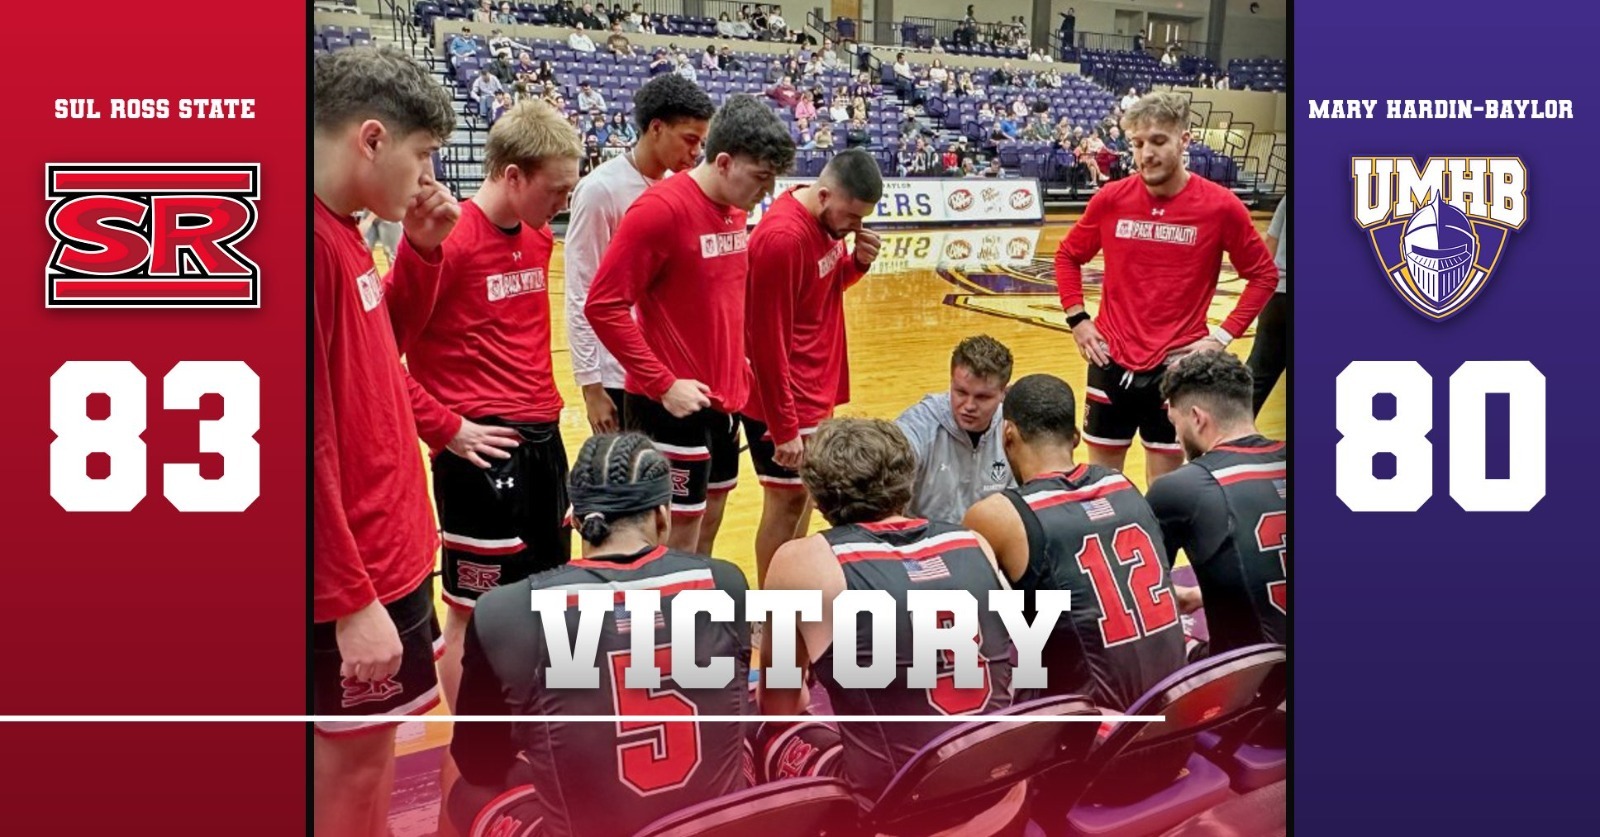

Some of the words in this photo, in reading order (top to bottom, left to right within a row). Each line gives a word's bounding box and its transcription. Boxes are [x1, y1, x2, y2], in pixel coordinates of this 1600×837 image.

[457, 565, 501, 589] SR
[1075, 522, 1179, 649] 12
[607, 642, 702, 798] 5
